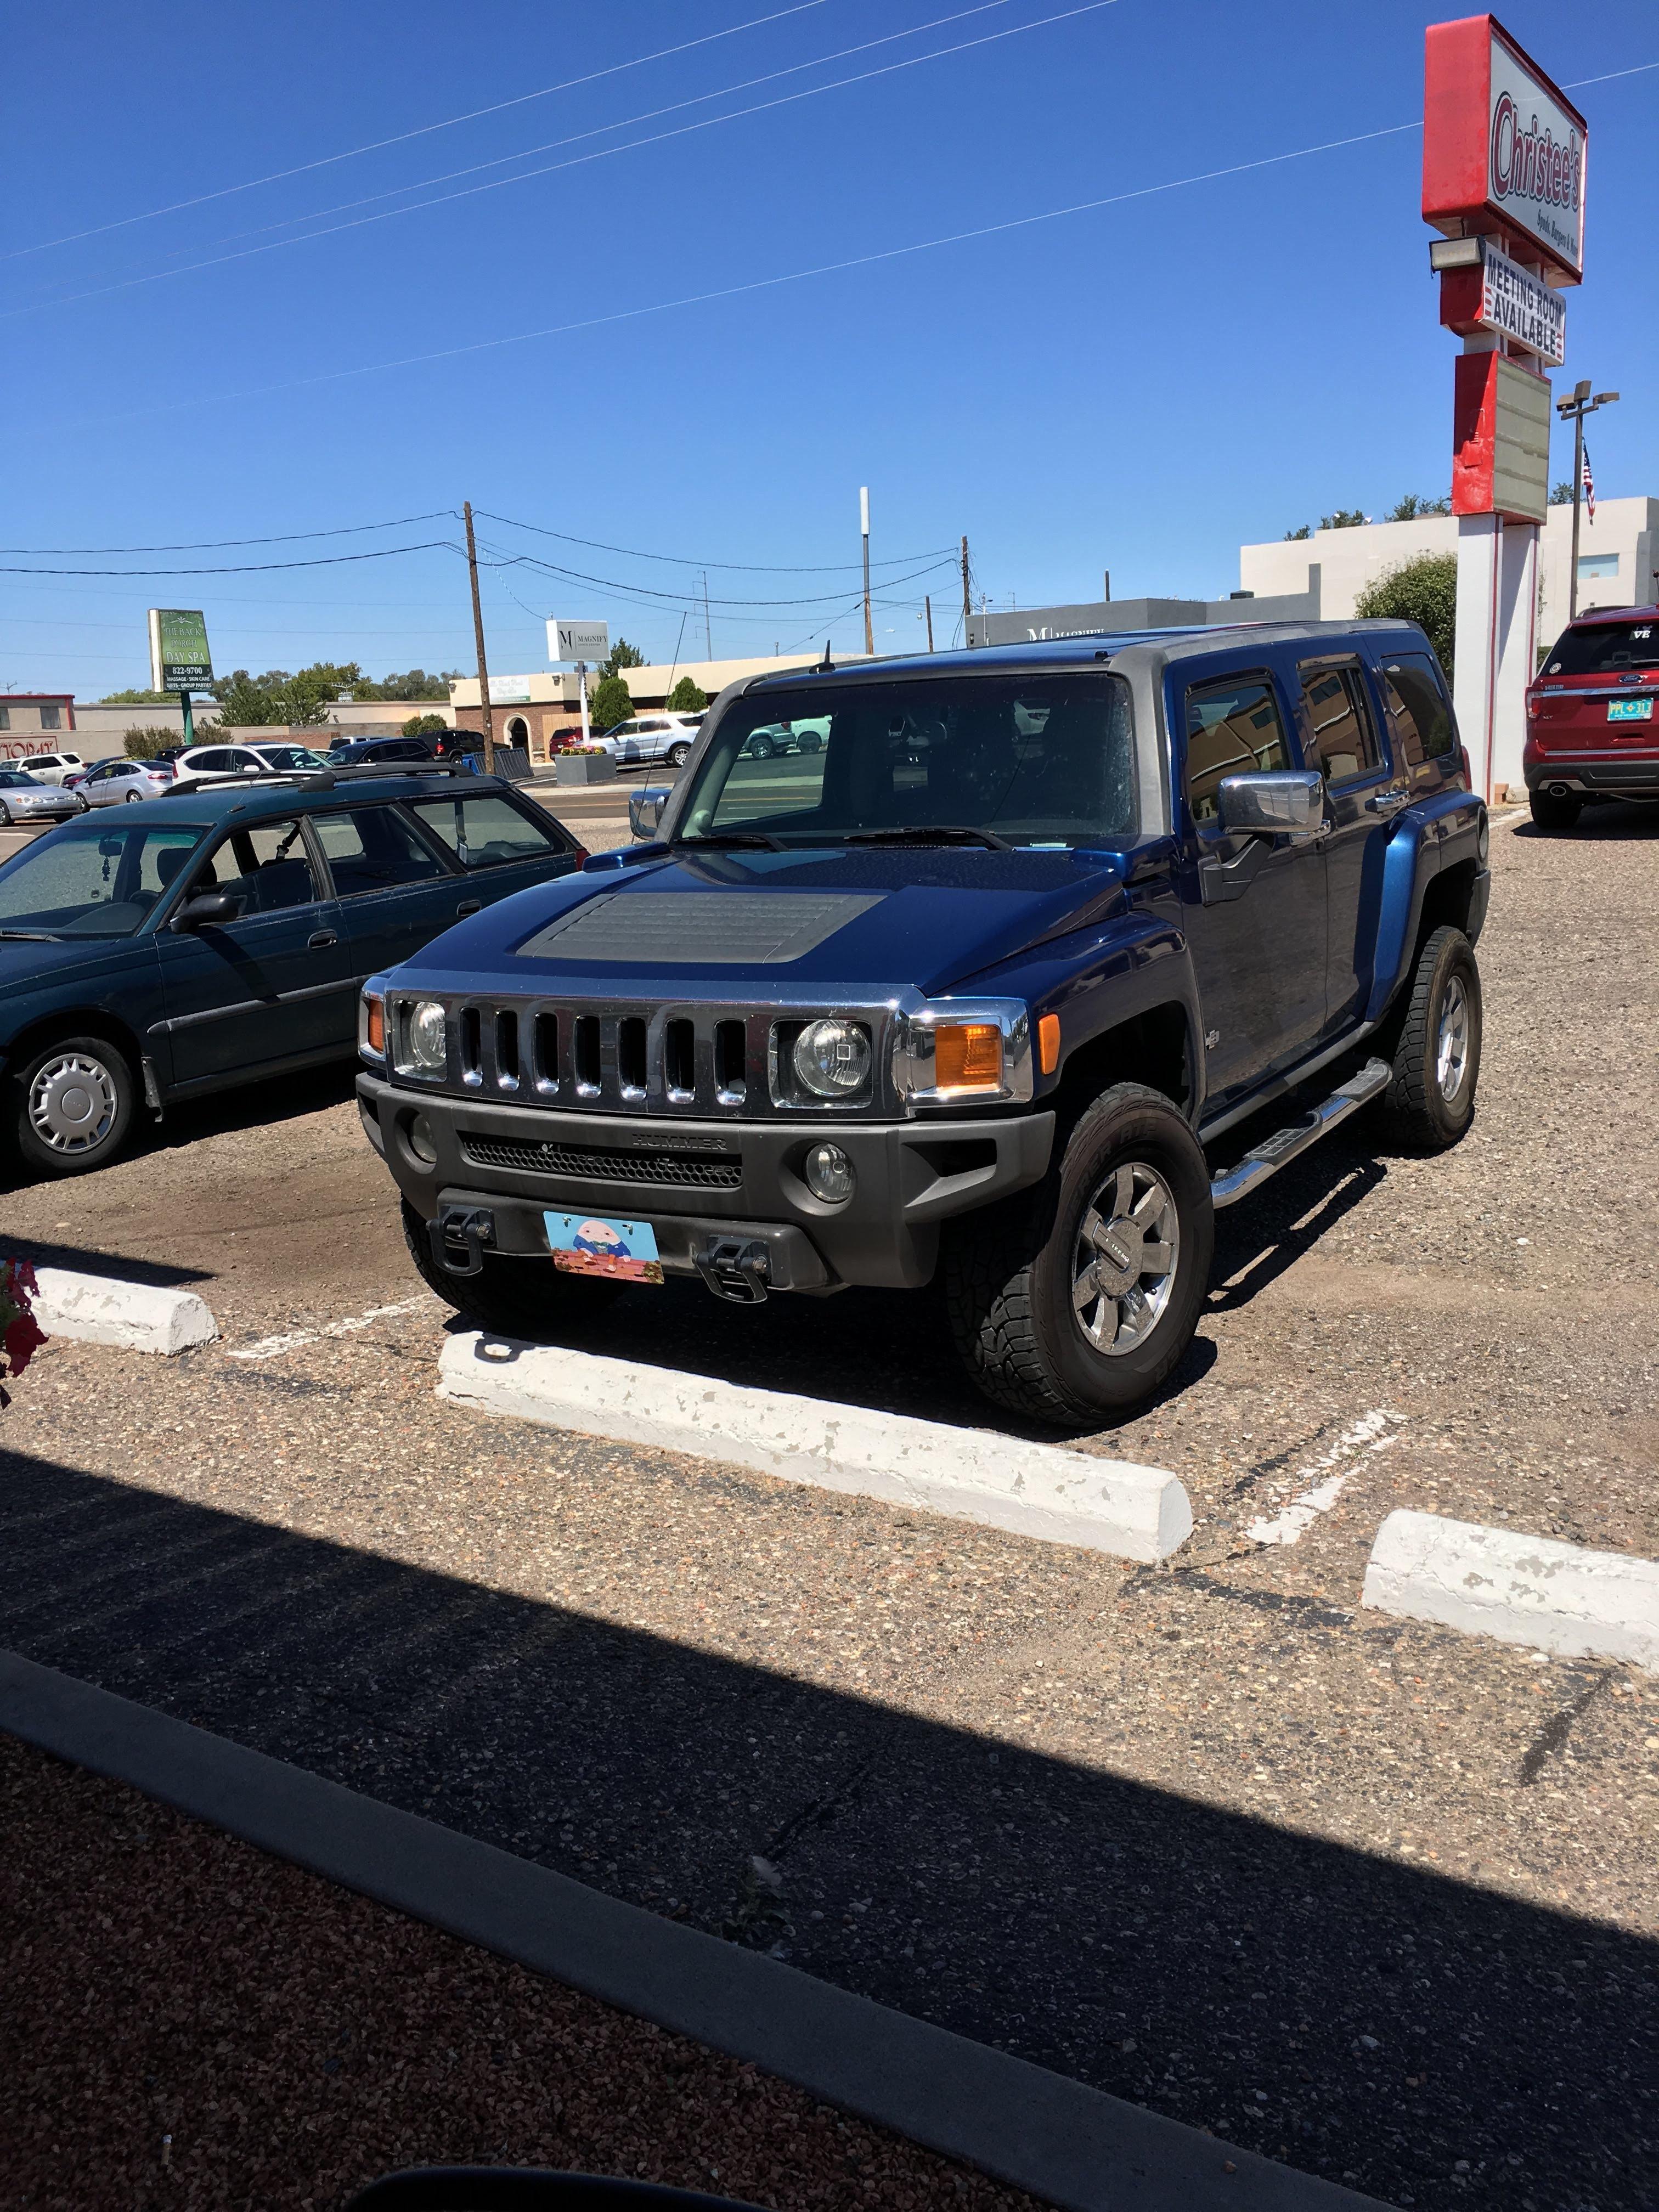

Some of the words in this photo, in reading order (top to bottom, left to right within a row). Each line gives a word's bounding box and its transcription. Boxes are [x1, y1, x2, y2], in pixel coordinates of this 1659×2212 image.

[1491, 91, 1581, 212] Christee's
[1487, 254, 1533, 310] MEETING
[1537, 288, 1561, 328] ROOM
[1494, 294, 1556, 356] AVAILABLE
[179, 628, 201, 636] BACK
[559, 630, 572, 650] M
[171, 639, 198, 648] PORCH
[166, 651, 184, 663] DAY
[188, 652, 205, 663] SPA
[632, 1133, 727, 1150] HUMMER
